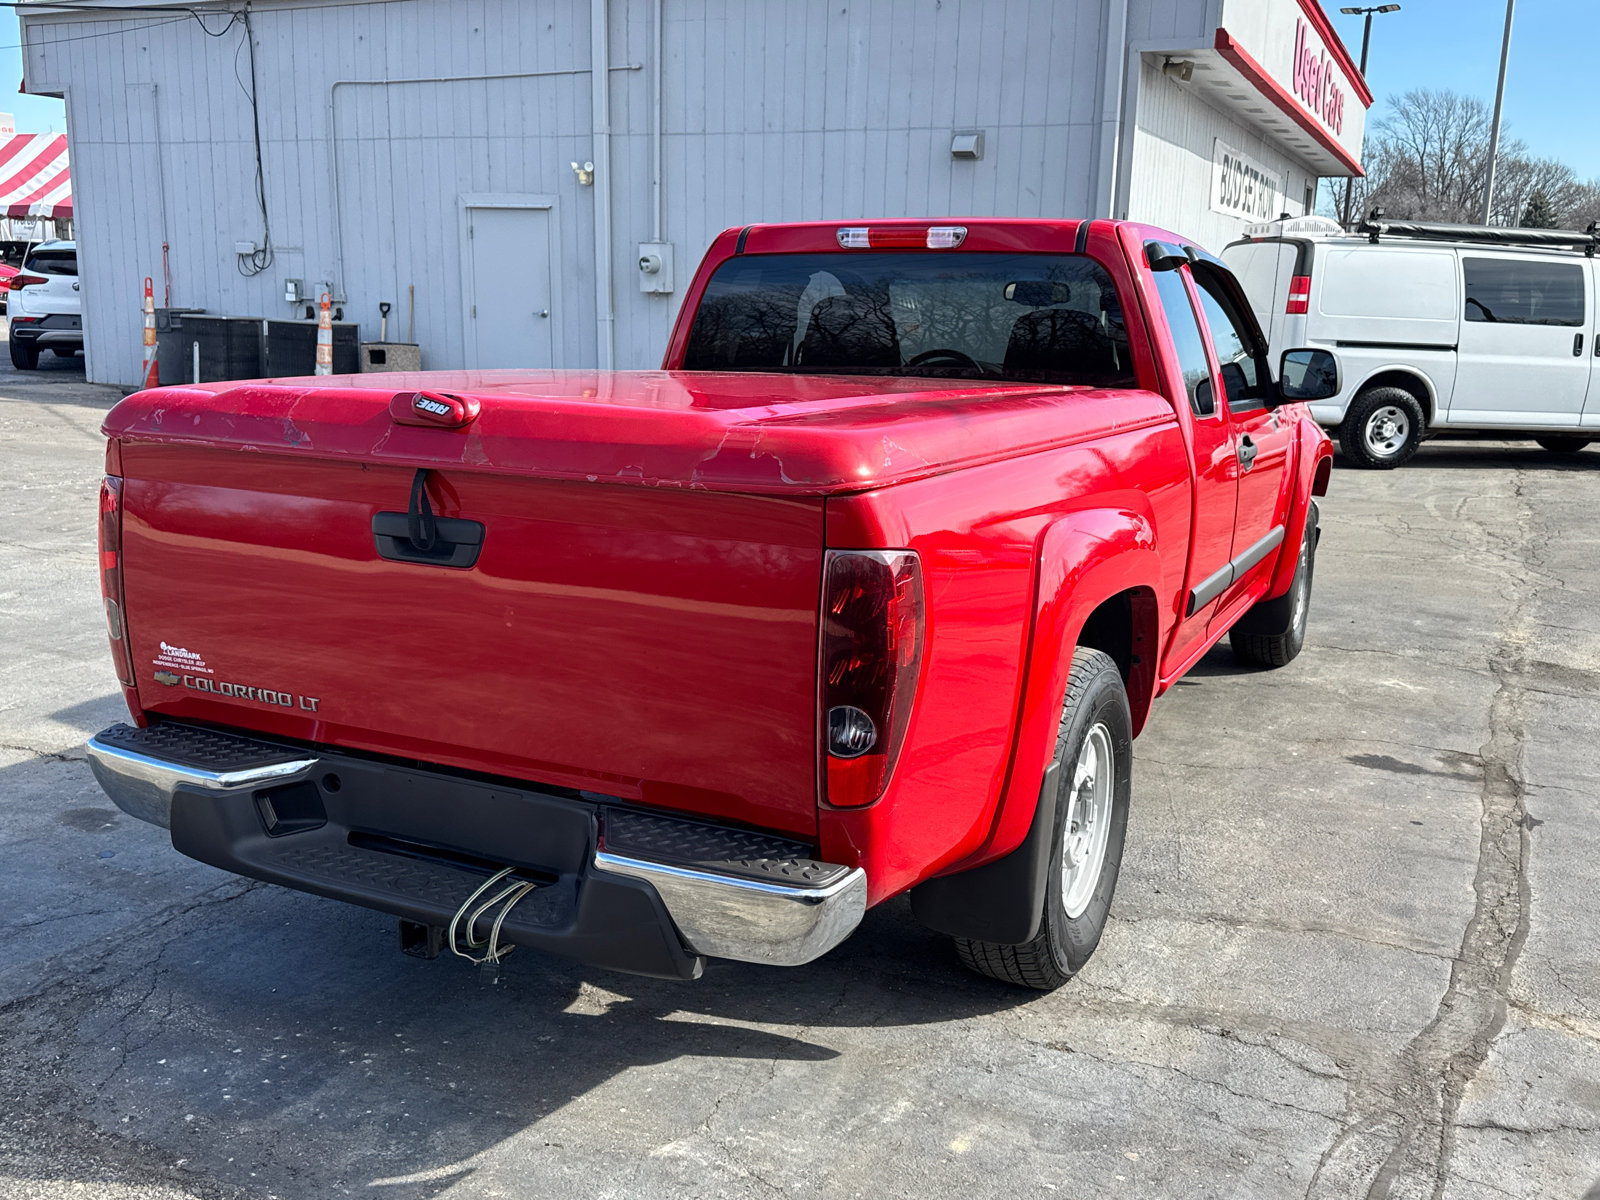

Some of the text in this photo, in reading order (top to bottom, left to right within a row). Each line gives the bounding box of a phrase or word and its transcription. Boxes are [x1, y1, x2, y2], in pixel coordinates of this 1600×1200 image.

[1293, 16, 1345, 136] Used Cars
[1220, 153, 1277, 221] BUDGET ROW
[415, 398, 451, 415] ARE
[166, 649, 202, 661] LANDMARK
[183, 674, 321, 712] COLORADO LT
